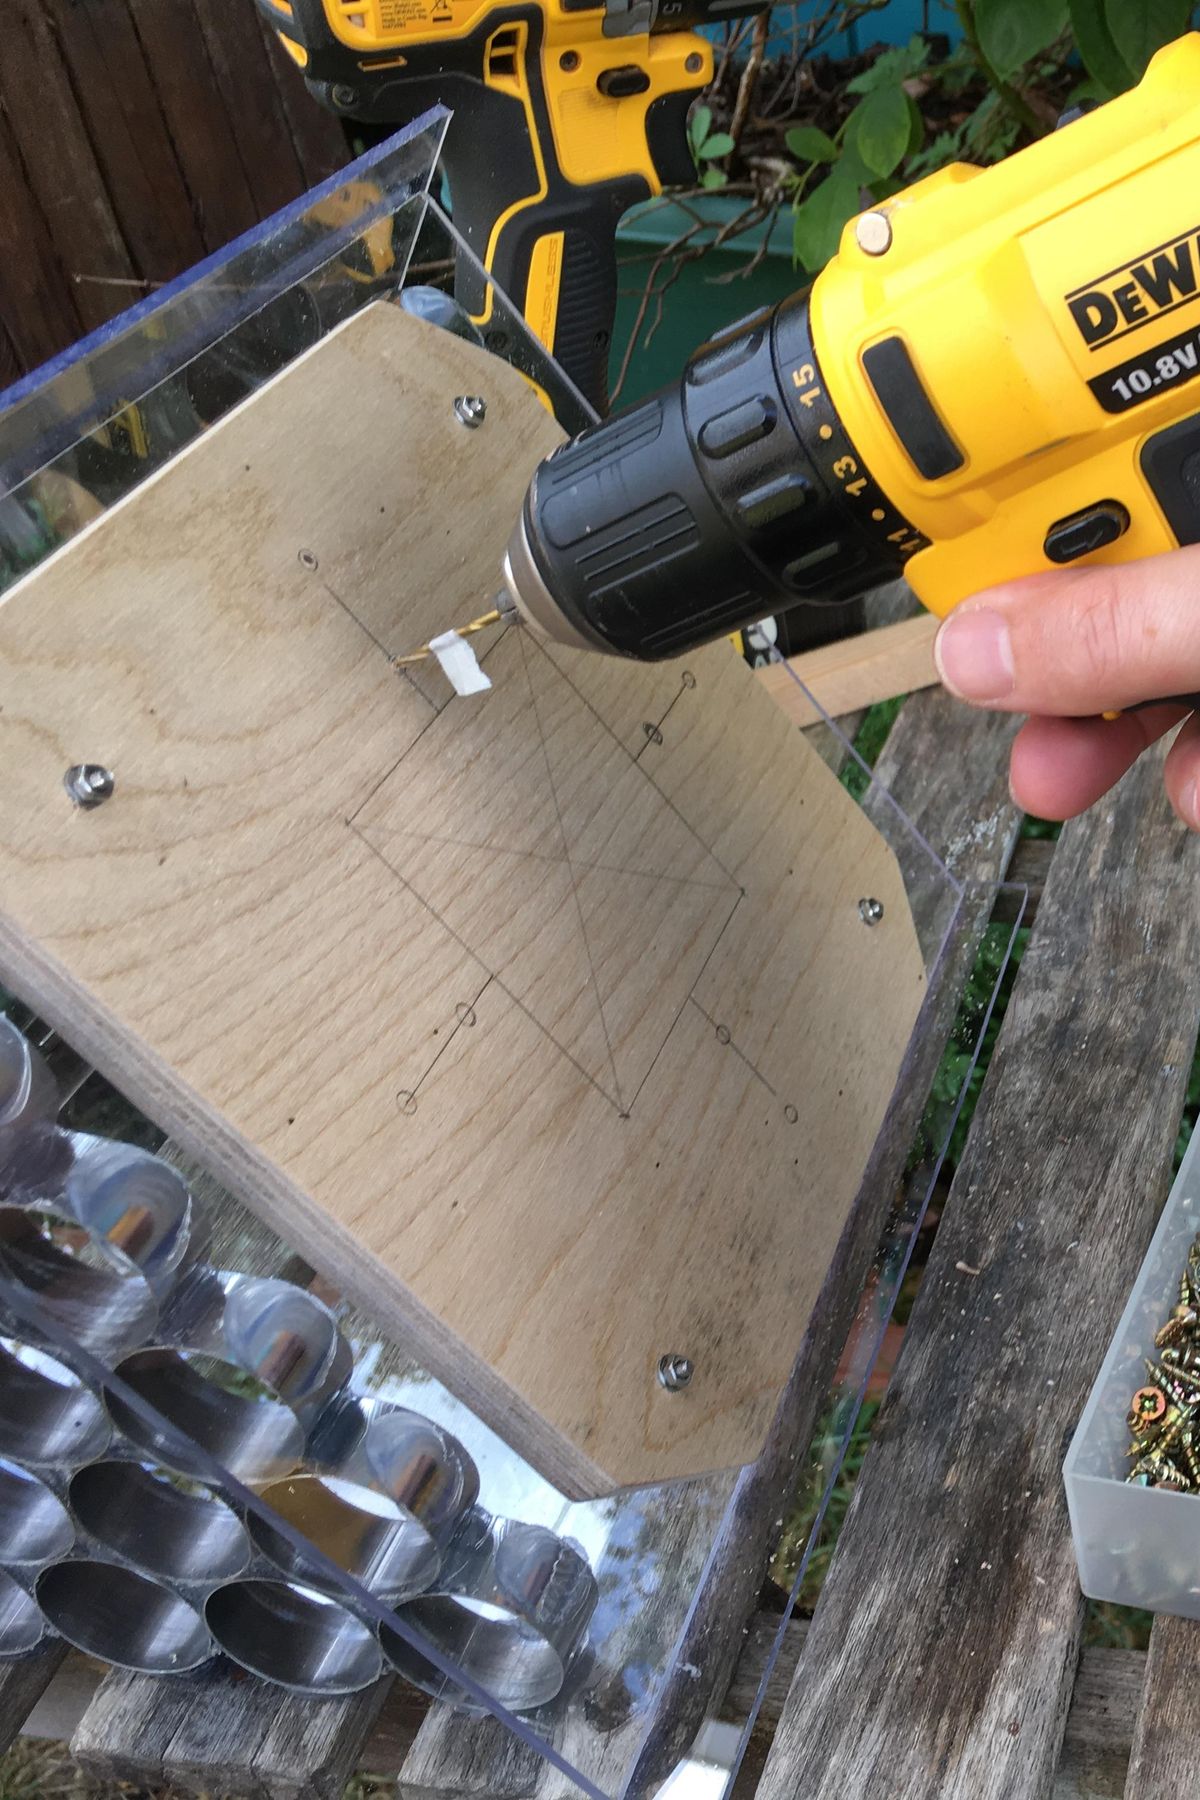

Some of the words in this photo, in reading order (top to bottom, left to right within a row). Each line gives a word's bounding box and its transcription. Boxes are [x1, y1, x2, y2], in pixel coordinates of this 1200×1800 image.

[792, 363, 821, 408] 15
[1111, 342, 1198, 401] 10.8V
[833, 455, 867, 497] 13
